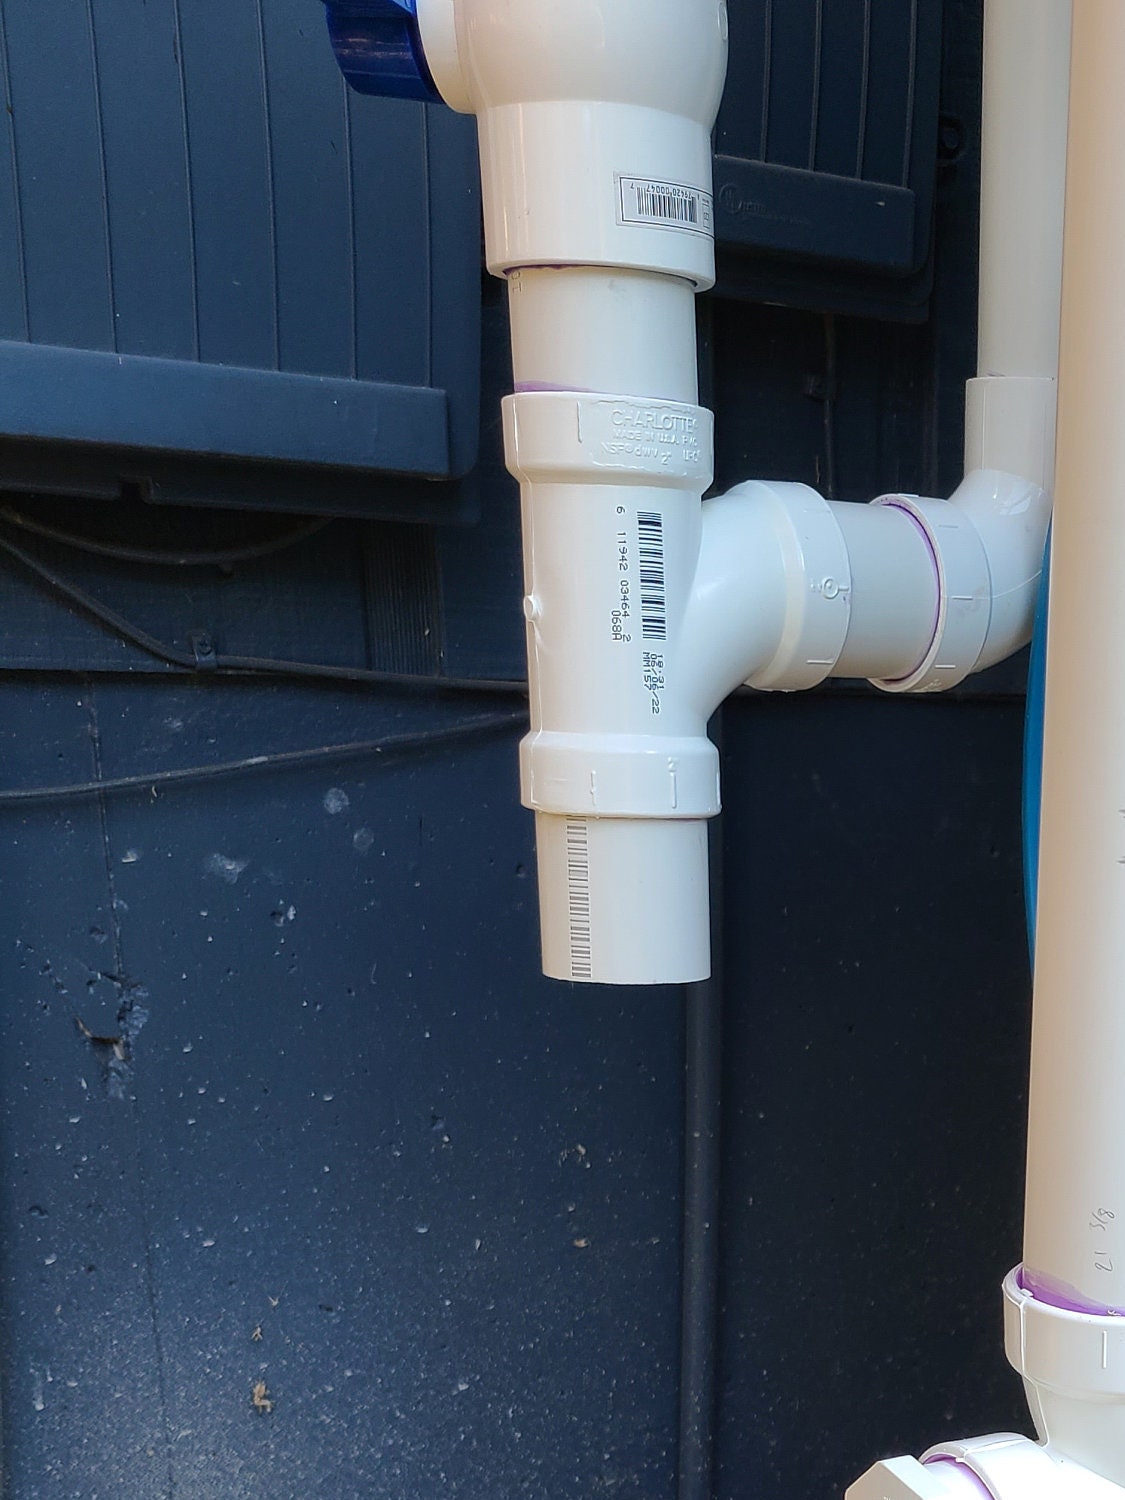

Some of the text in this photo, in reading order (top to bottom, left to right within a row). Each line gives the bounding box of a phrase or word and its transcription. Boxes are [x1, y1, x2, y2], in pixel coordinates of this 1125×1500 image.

[616, 505, 626, 515] 6
[617, 531, 629, 572] 11942
[620, 579, 630, 618] 03464
